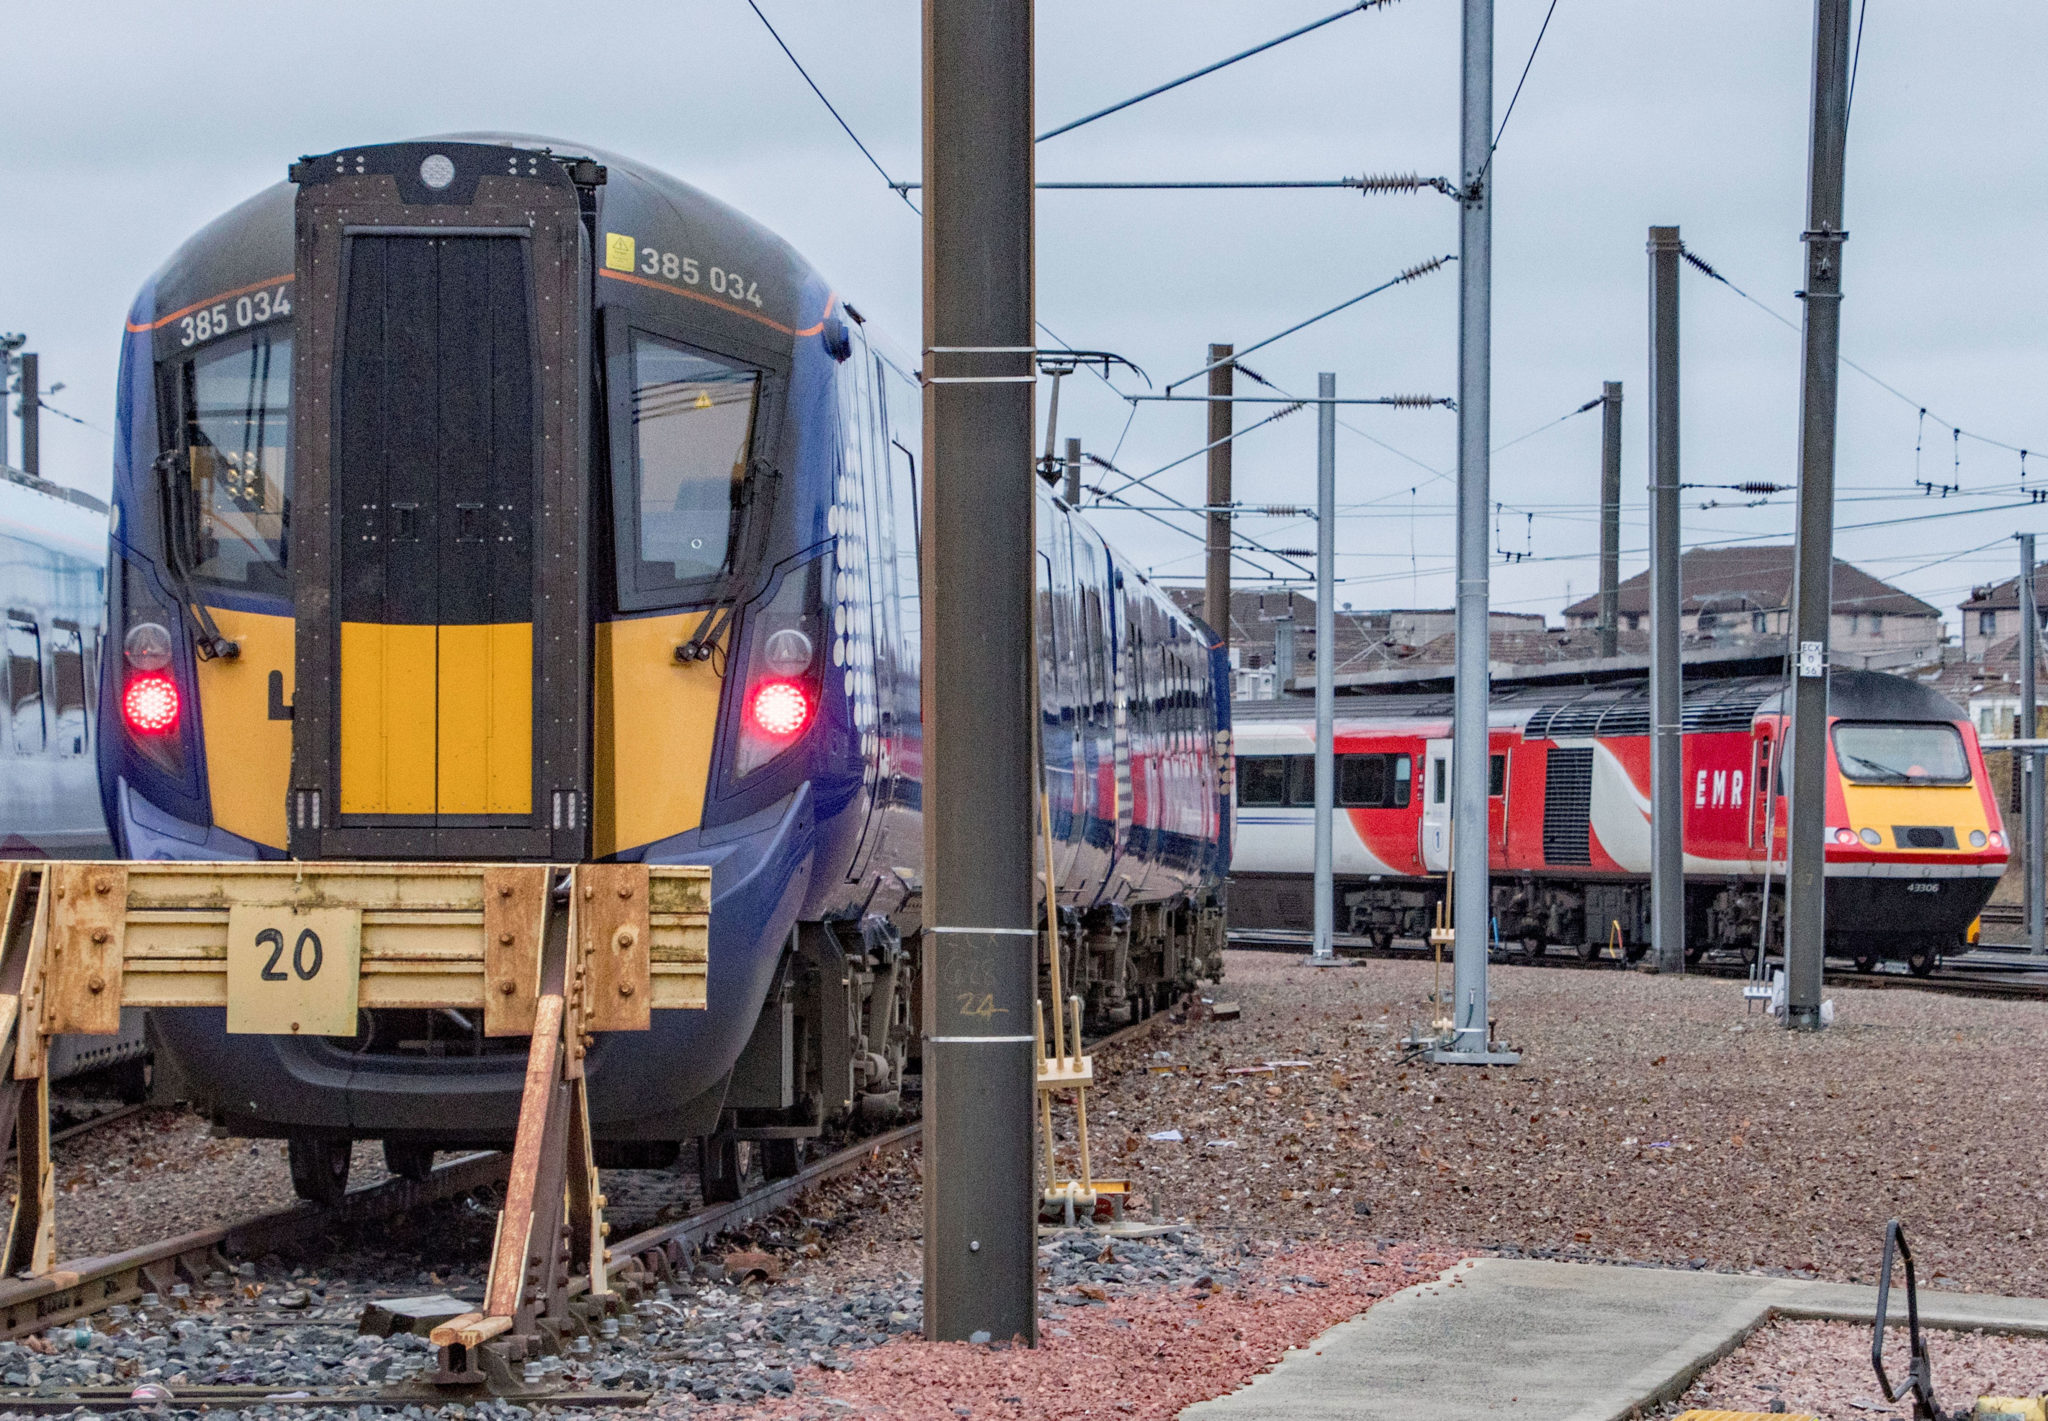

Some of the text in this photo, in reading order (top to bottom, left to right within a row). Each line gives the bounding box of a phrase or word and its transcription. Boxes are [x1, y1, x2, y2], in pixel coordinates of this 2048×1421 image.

[641, 247, 763, 308] 385 034
[180, 286, 292, 347] 385 034
[1694, 769, 1744, 809] EMR
[1906, 882, 1940, 893] 43306
[254, 927, 323, 981] 20
[957, 991, 1009, 1020] 24
